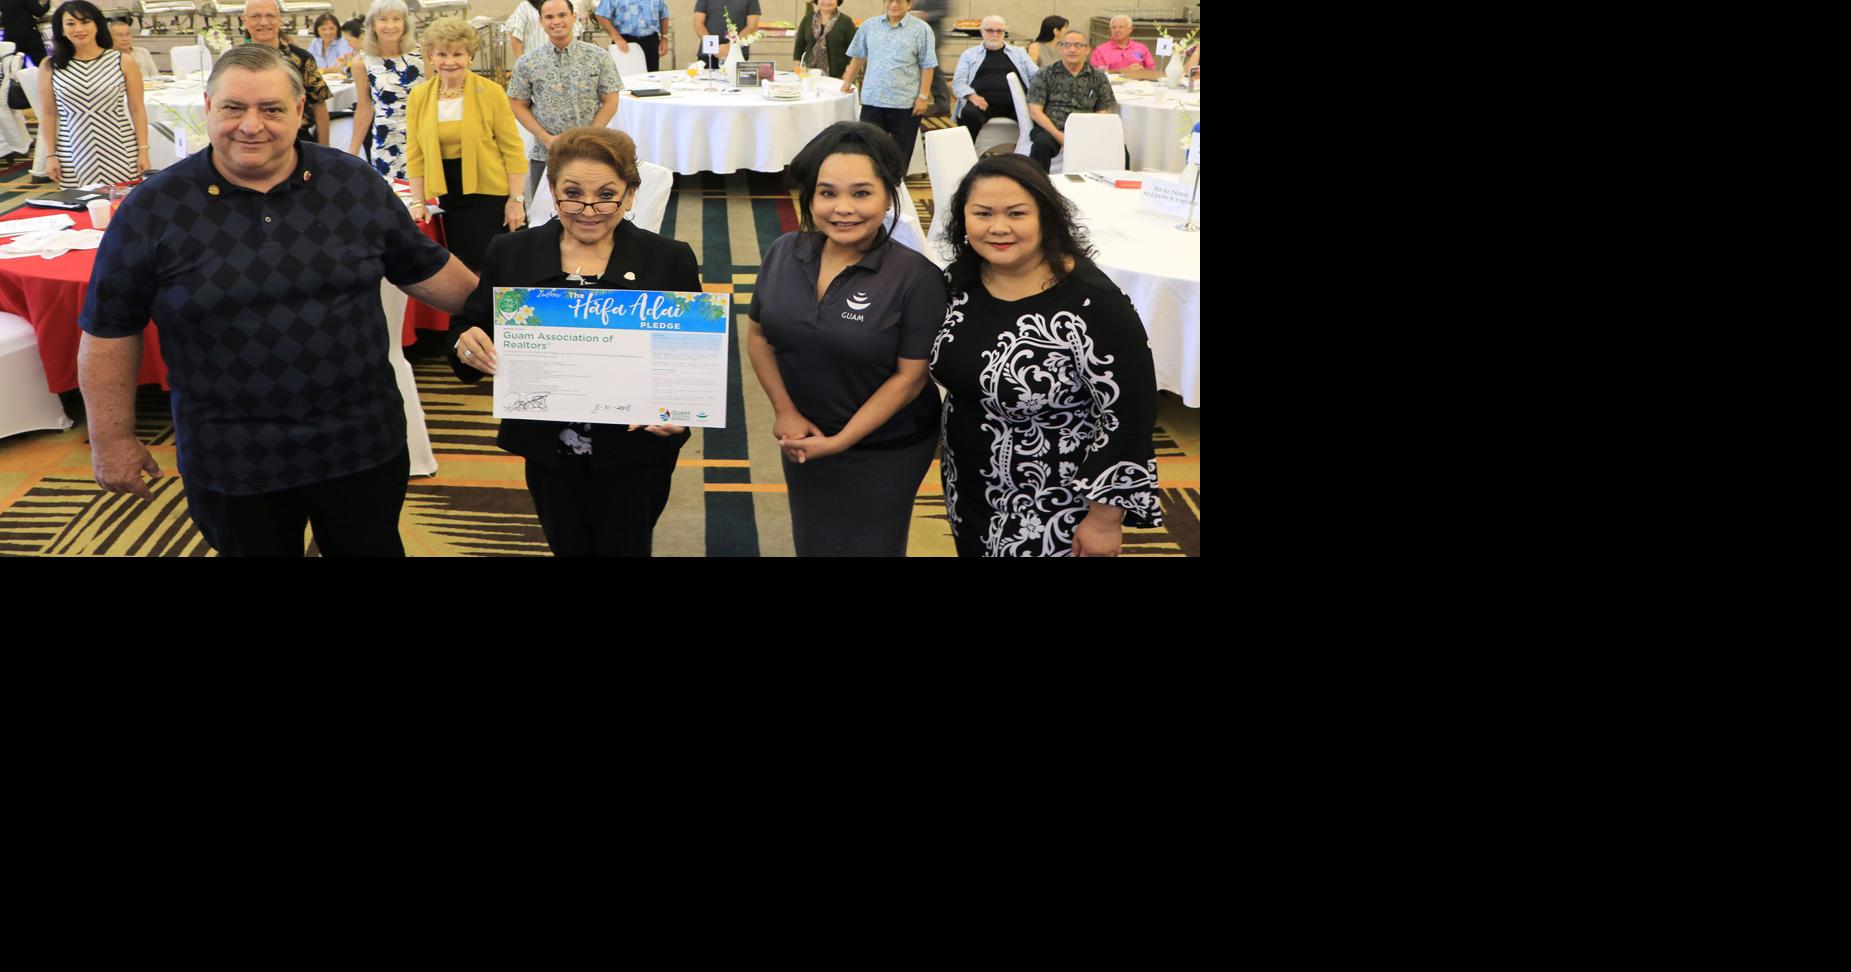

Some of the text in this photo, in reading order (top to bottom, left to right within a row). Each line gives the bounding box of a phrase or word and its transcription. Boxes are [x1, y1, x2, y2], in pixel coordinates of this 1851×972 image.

[569, 291, 585, 299] The
[629, 293, 684, 321] Adai
[840, 311, 864, 322] GUAM
[640, 321, 681, 330] PLEDGE
[503, 331, 613, 343] Guam Association of
